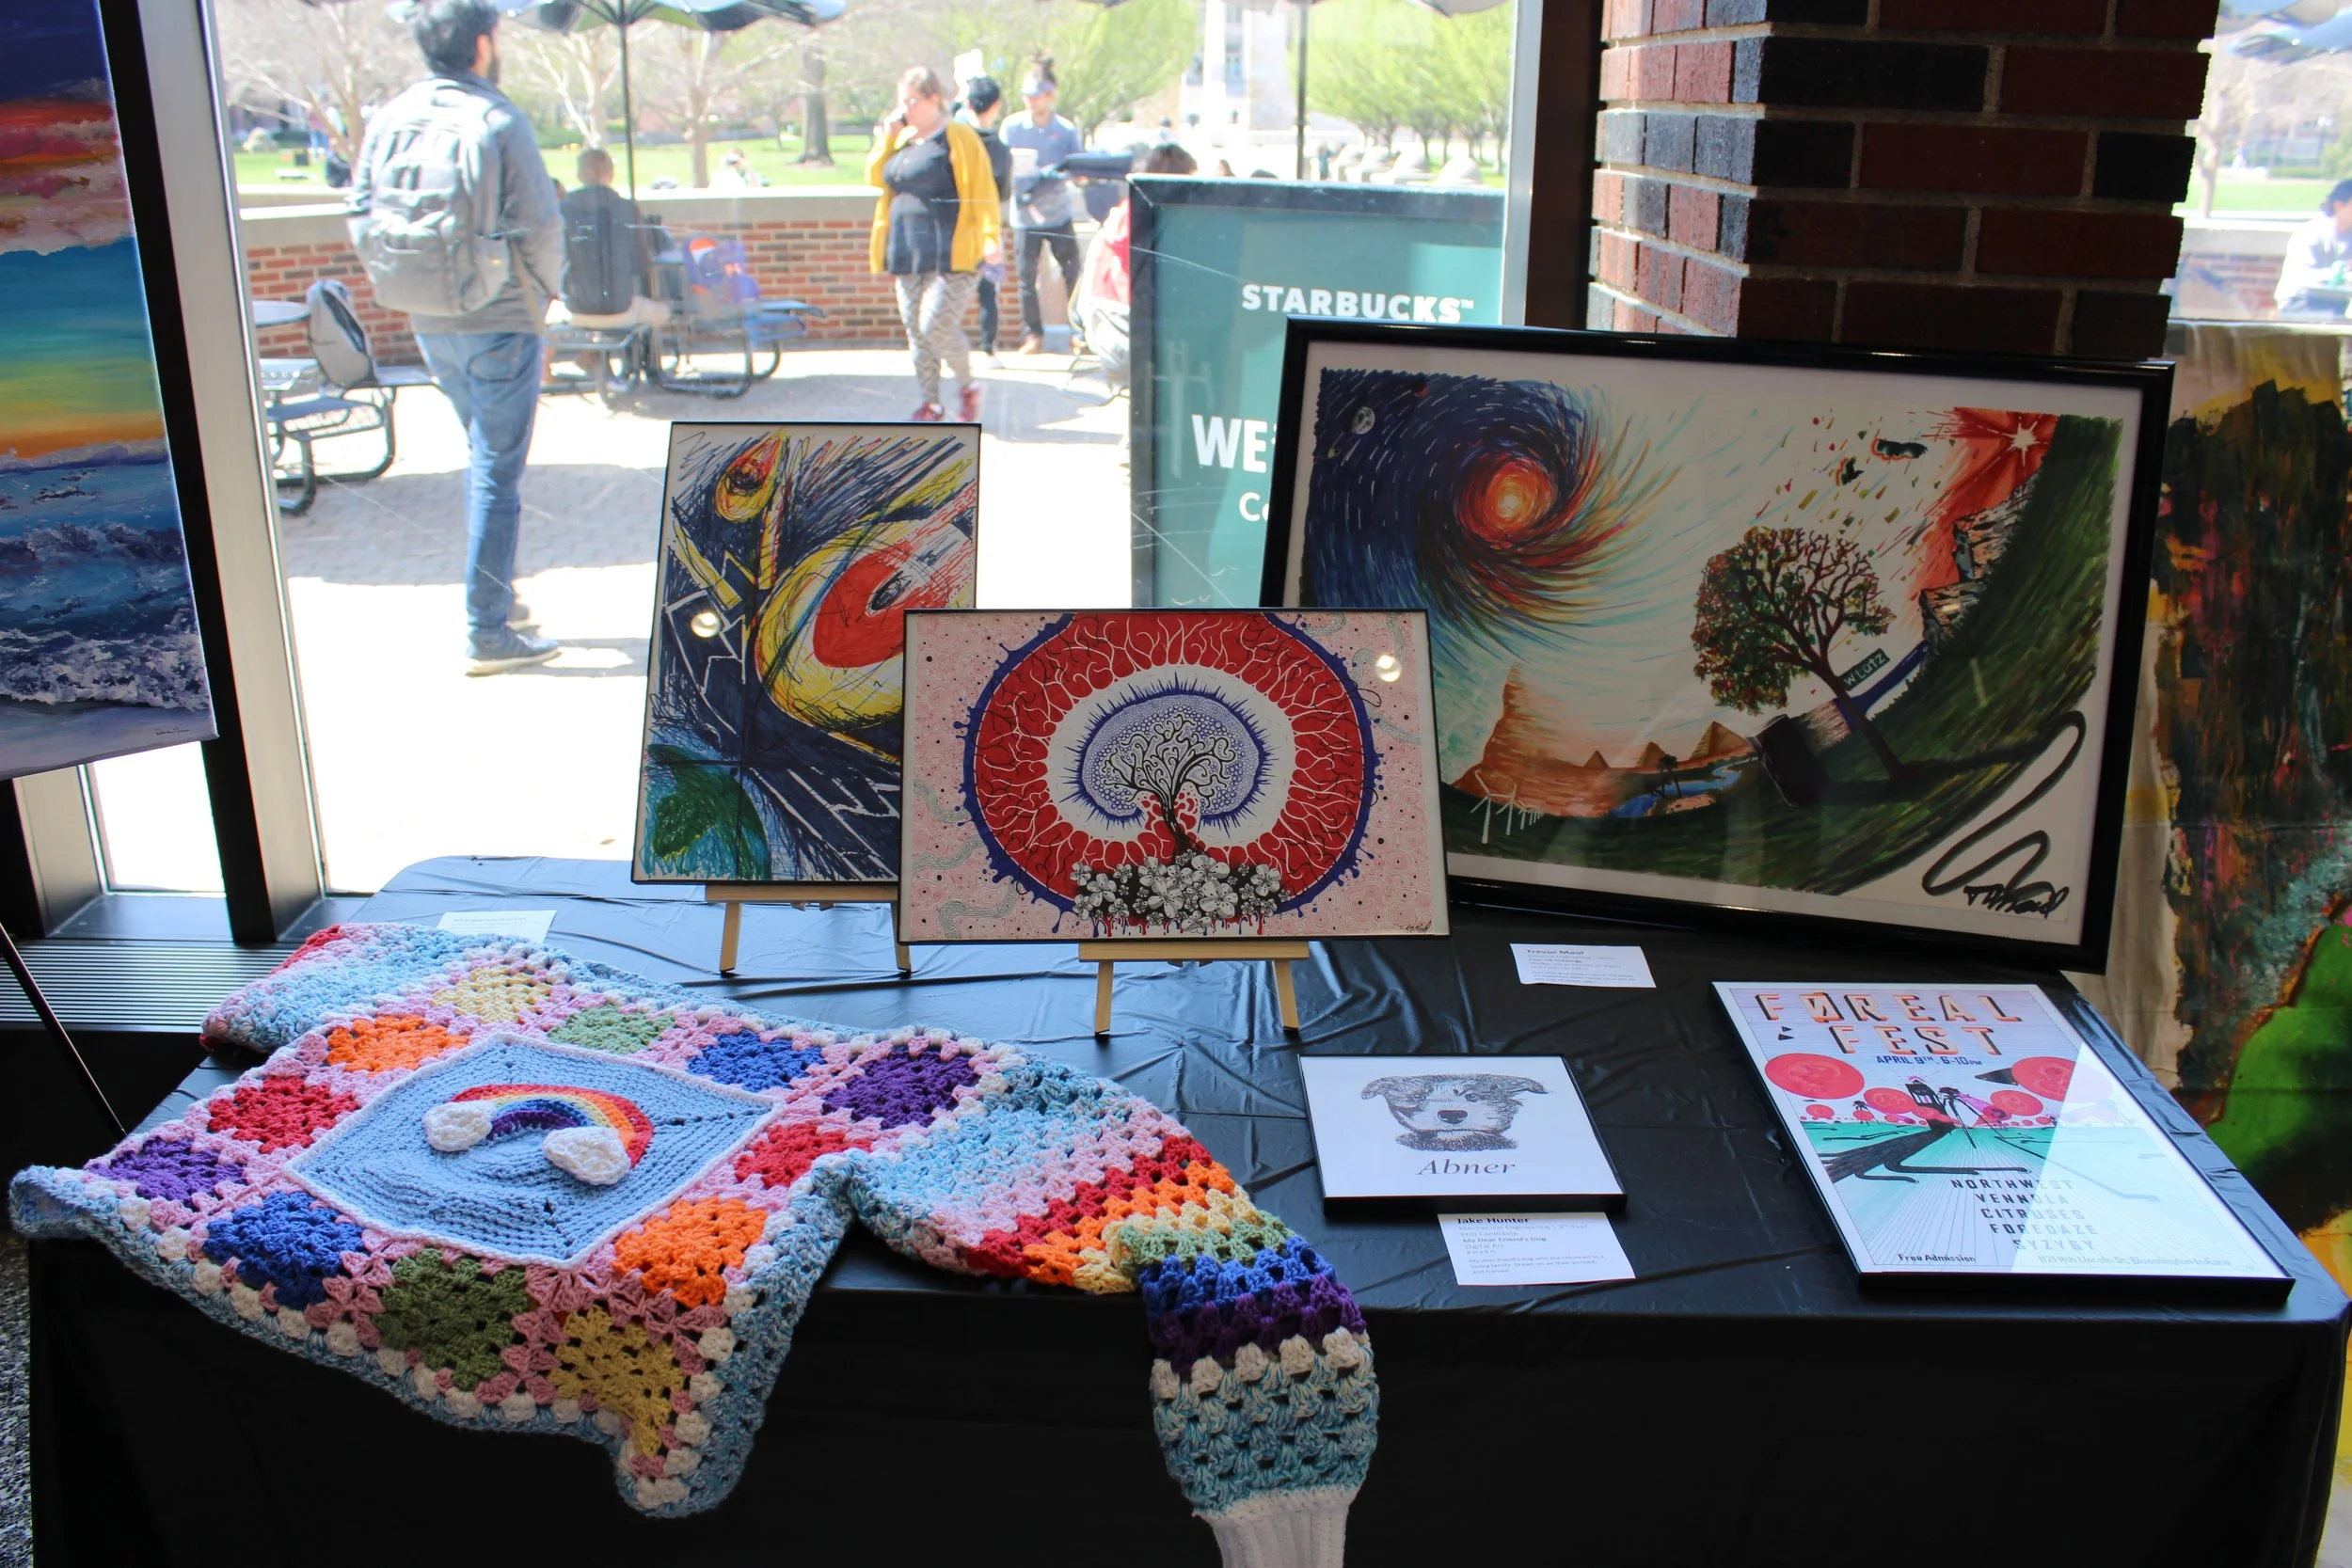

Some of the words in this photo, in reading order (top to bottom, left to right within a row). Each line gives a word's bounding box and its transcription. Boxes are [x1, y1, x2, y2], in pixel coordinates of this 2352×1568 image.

[1828, 1025, 2002, 1055] FEST
[1876, 1055, 1914, 1064] APRIL
[1415, 1158, 1516, 1175] Abner
[1950, 1179, 2073, 1190] NORTHWEST
[1980, 1208, 2086, 1220] CITRUSES
[1990, 1224, 2099, 1235] FOREDAZE
[2012, 1239, 2096, 1251] SYZYGY
[1898, 1253, 1923, 1261] Free
[1925, 1254, 1976, 1262] Admission
